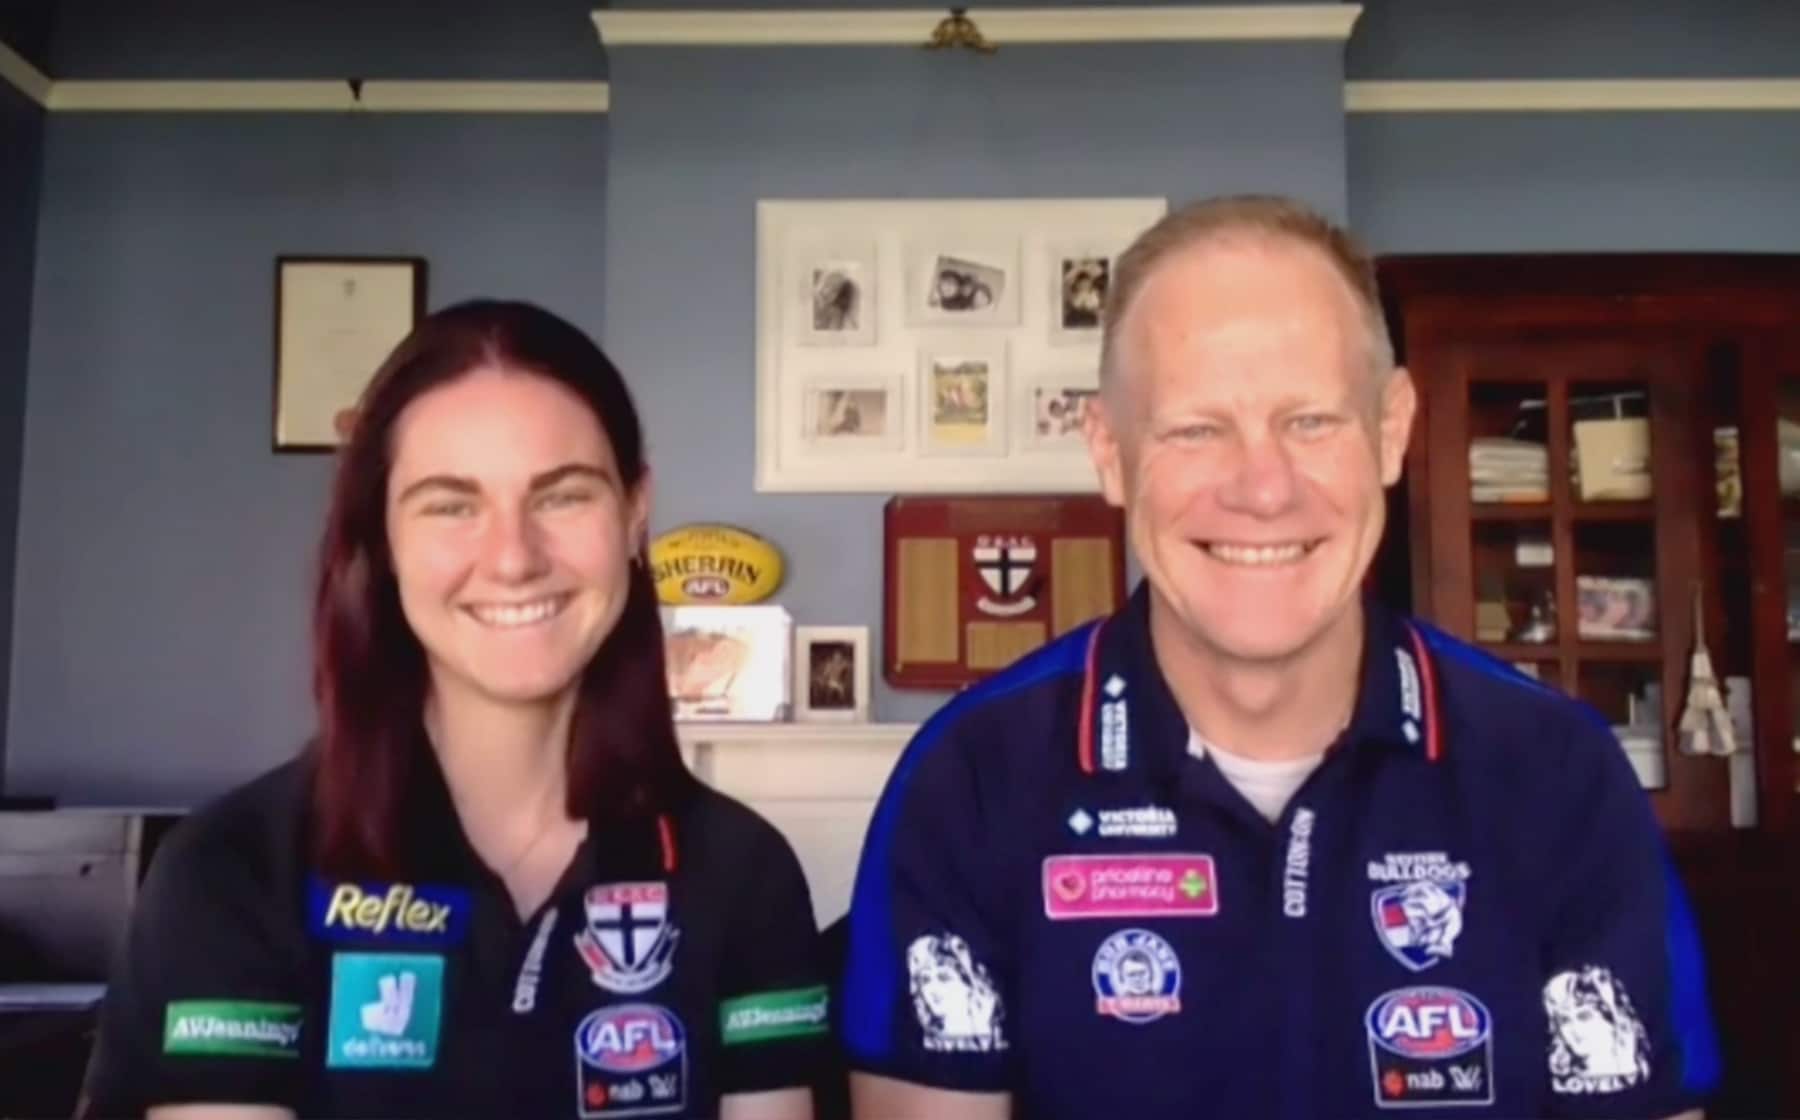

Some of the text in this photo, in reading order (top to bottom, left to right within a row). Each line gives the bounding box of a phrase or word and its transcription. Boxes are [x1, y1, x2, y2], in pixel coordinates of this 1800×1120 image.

[326, 884, 451, 934] Reflex
[1382, 1005, 1479, 1038] AFL
[588, 1022, 676, 1055] AFL
[610, 1080, 644, 1099] nab
[1408, 1070, 1444, 1089] nab
